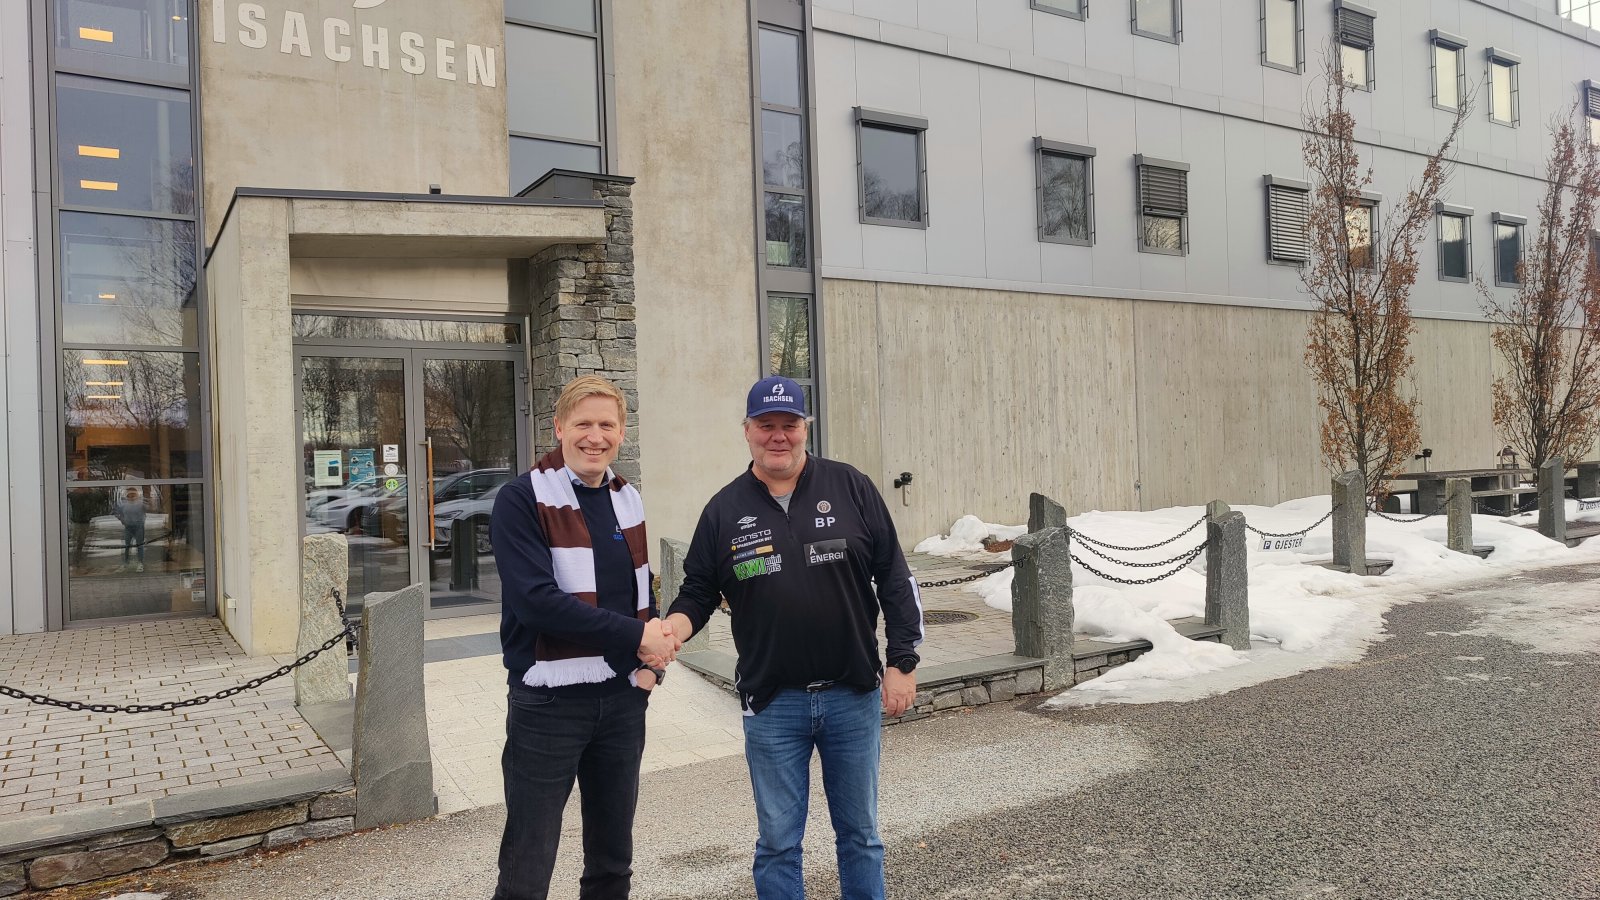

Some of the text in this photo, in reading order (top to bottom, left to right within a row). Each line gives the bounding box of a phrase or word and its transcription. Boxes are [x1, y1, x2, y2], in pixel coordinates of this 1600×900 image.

[212, 0, 496, 88] ISACHSEN
[815, 516, 835, 528] BP
[1274, 538, 1302, 549] GJESTER
[809, 544, 816, 555] Å
[810, 552, 843, 563] ENERGI
[733, 557, 767, 581] KIWI
